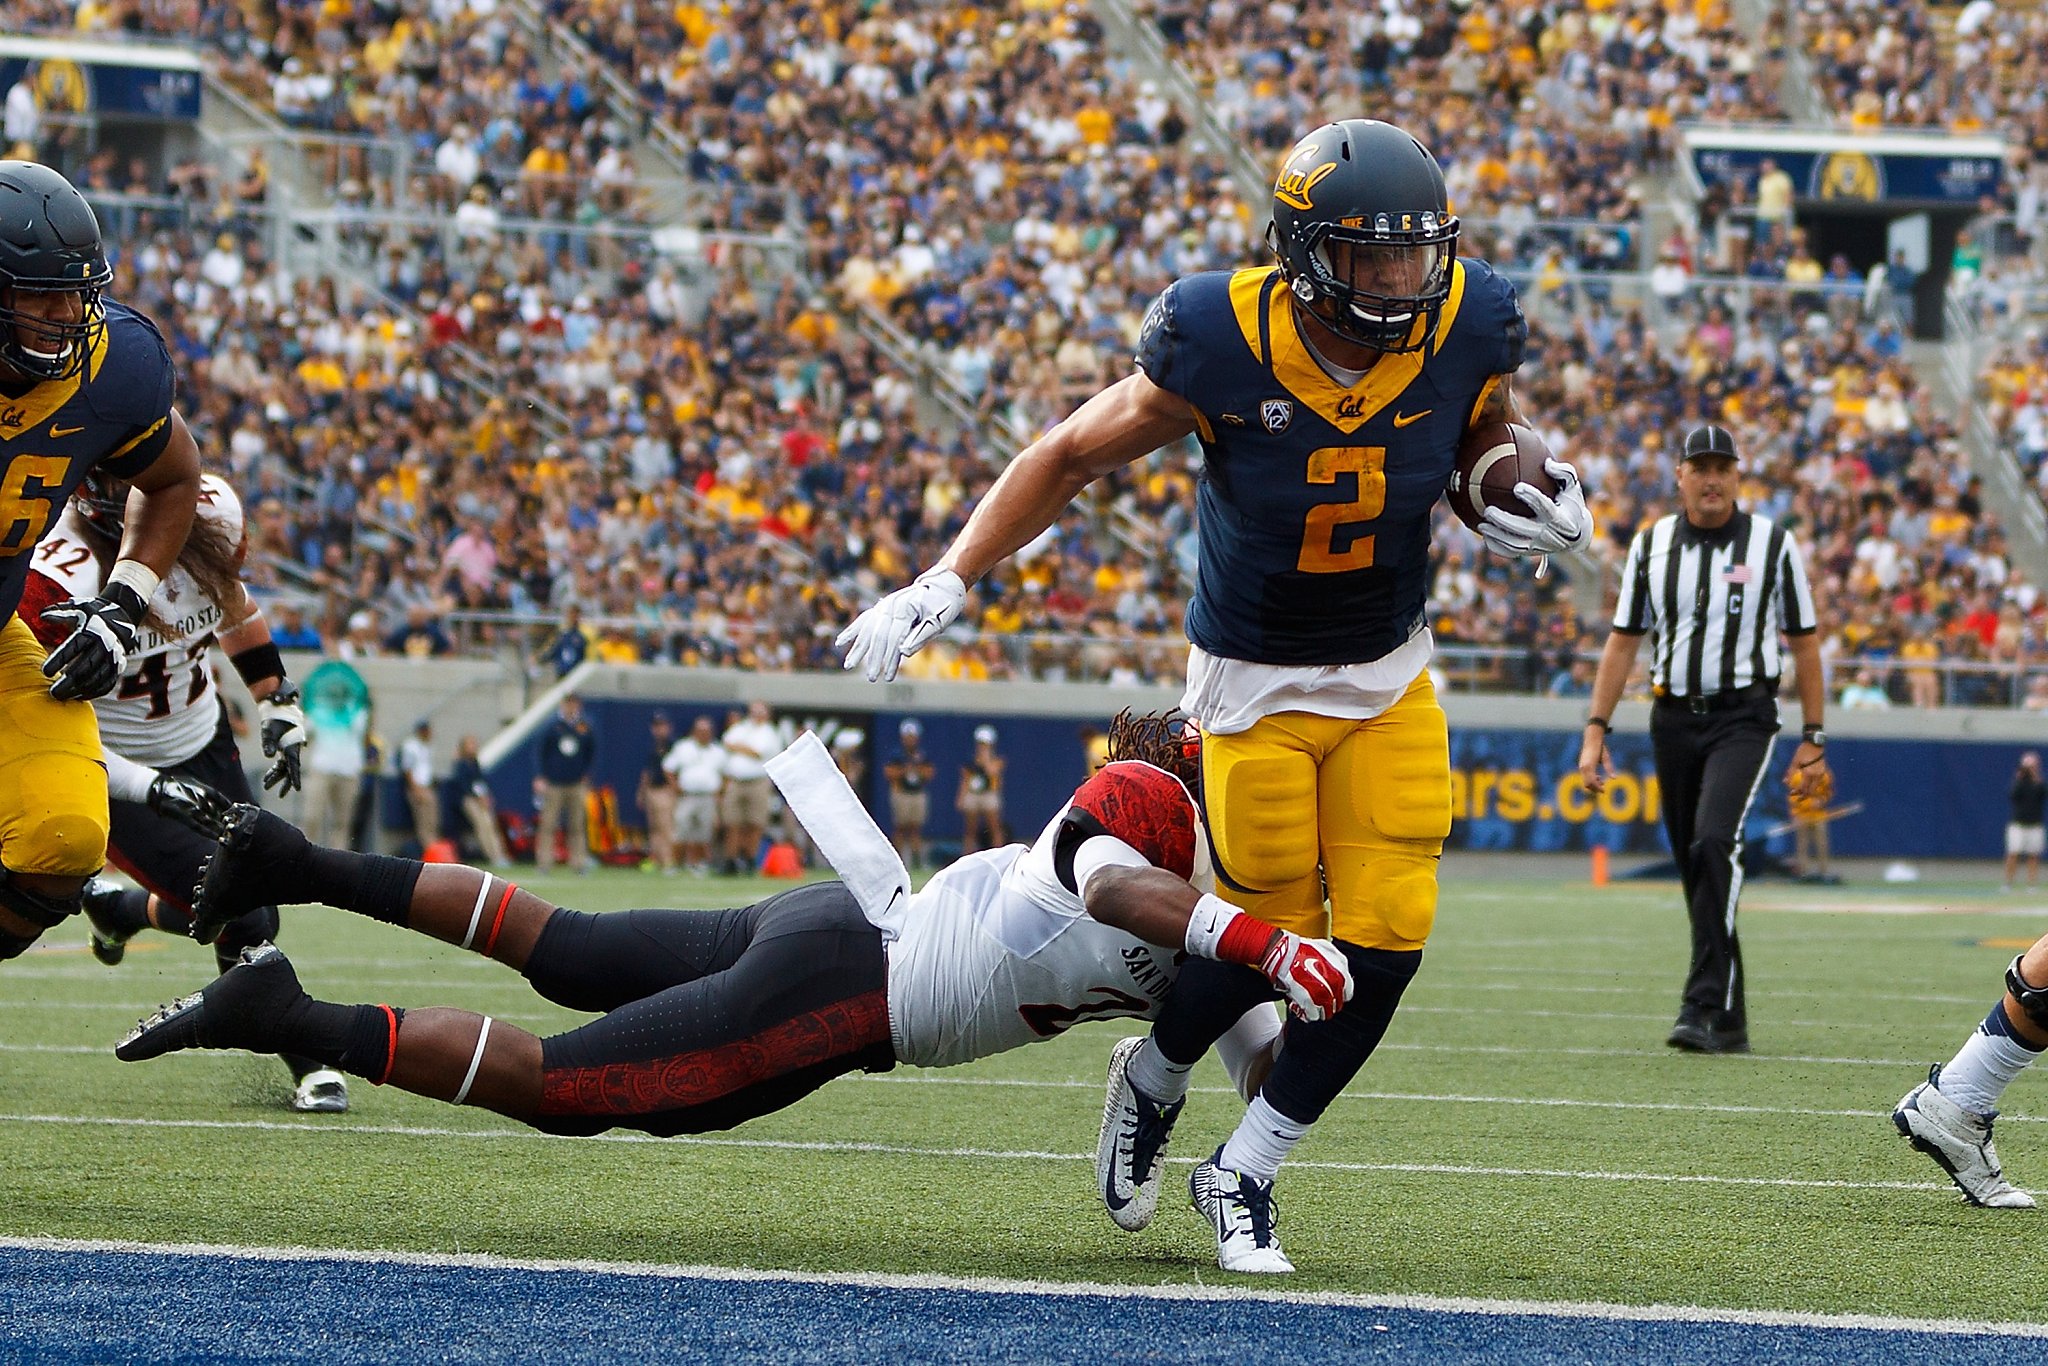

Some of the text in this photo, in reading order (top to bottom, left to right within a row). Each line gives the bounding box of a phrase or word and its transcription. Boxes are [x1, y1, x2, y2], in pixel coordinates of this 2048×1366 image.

[1274, 143, 1338, 211] Cal
[1341, 216, 1364, 228] NIKE
[1, 406, 26, 427] Cal
[1262, 402, 1291, 422] PAC
[1337, 395, 1366, 419] Cal
[1268, 415, 1284, 429] 12
[0, 454, 73, 558] 6
[1297, 446, 1386, 573] 2
[38, 538, 91, 577] 42
[1729, 594, 1741, 614] C
[1120, 945, 1162, 988] SAN
